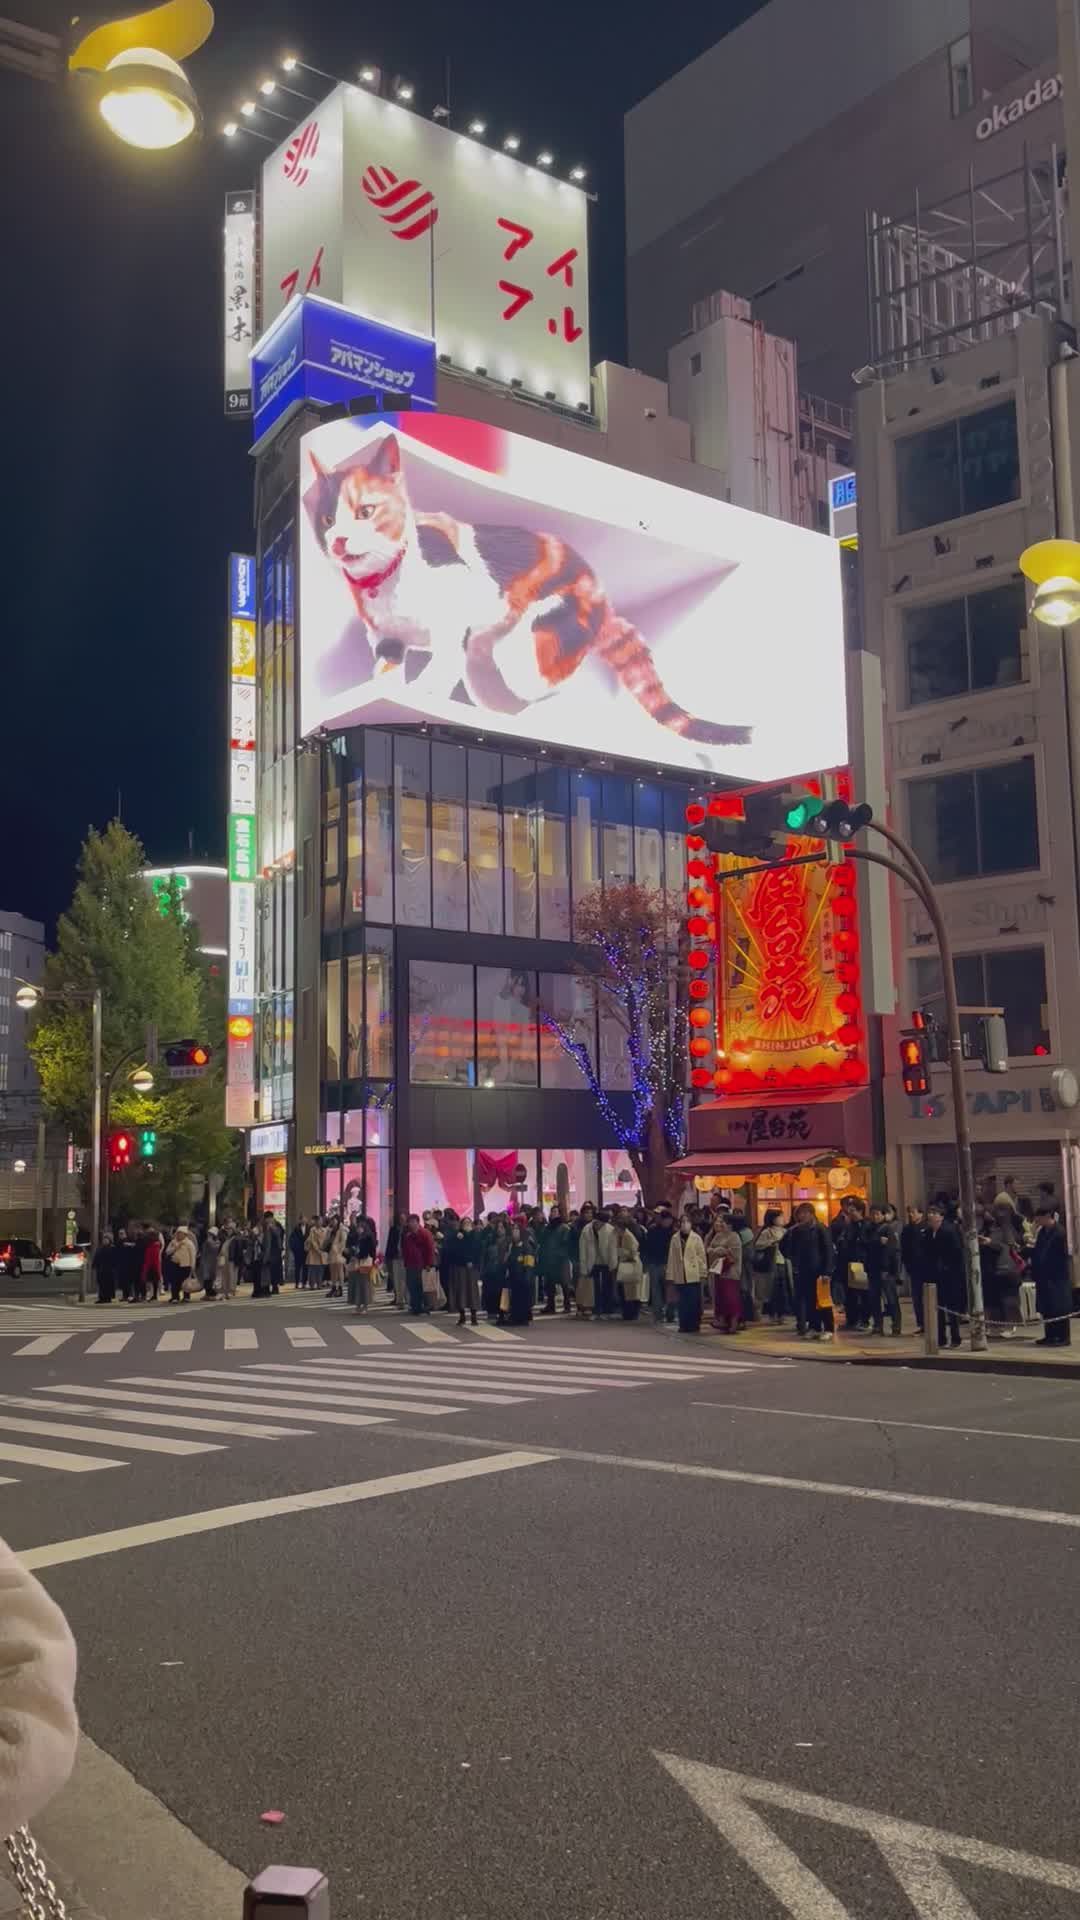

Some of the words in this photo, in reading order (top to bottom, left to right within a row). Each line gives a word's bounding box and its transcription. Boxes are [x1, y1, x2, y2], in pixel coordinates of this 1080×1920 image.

[331, 346, 416, 388] アパマンショップ
[754, 1036, 819, 1052] SHINJUKU
[746, 1108, 813, 1144] 屋台苑
